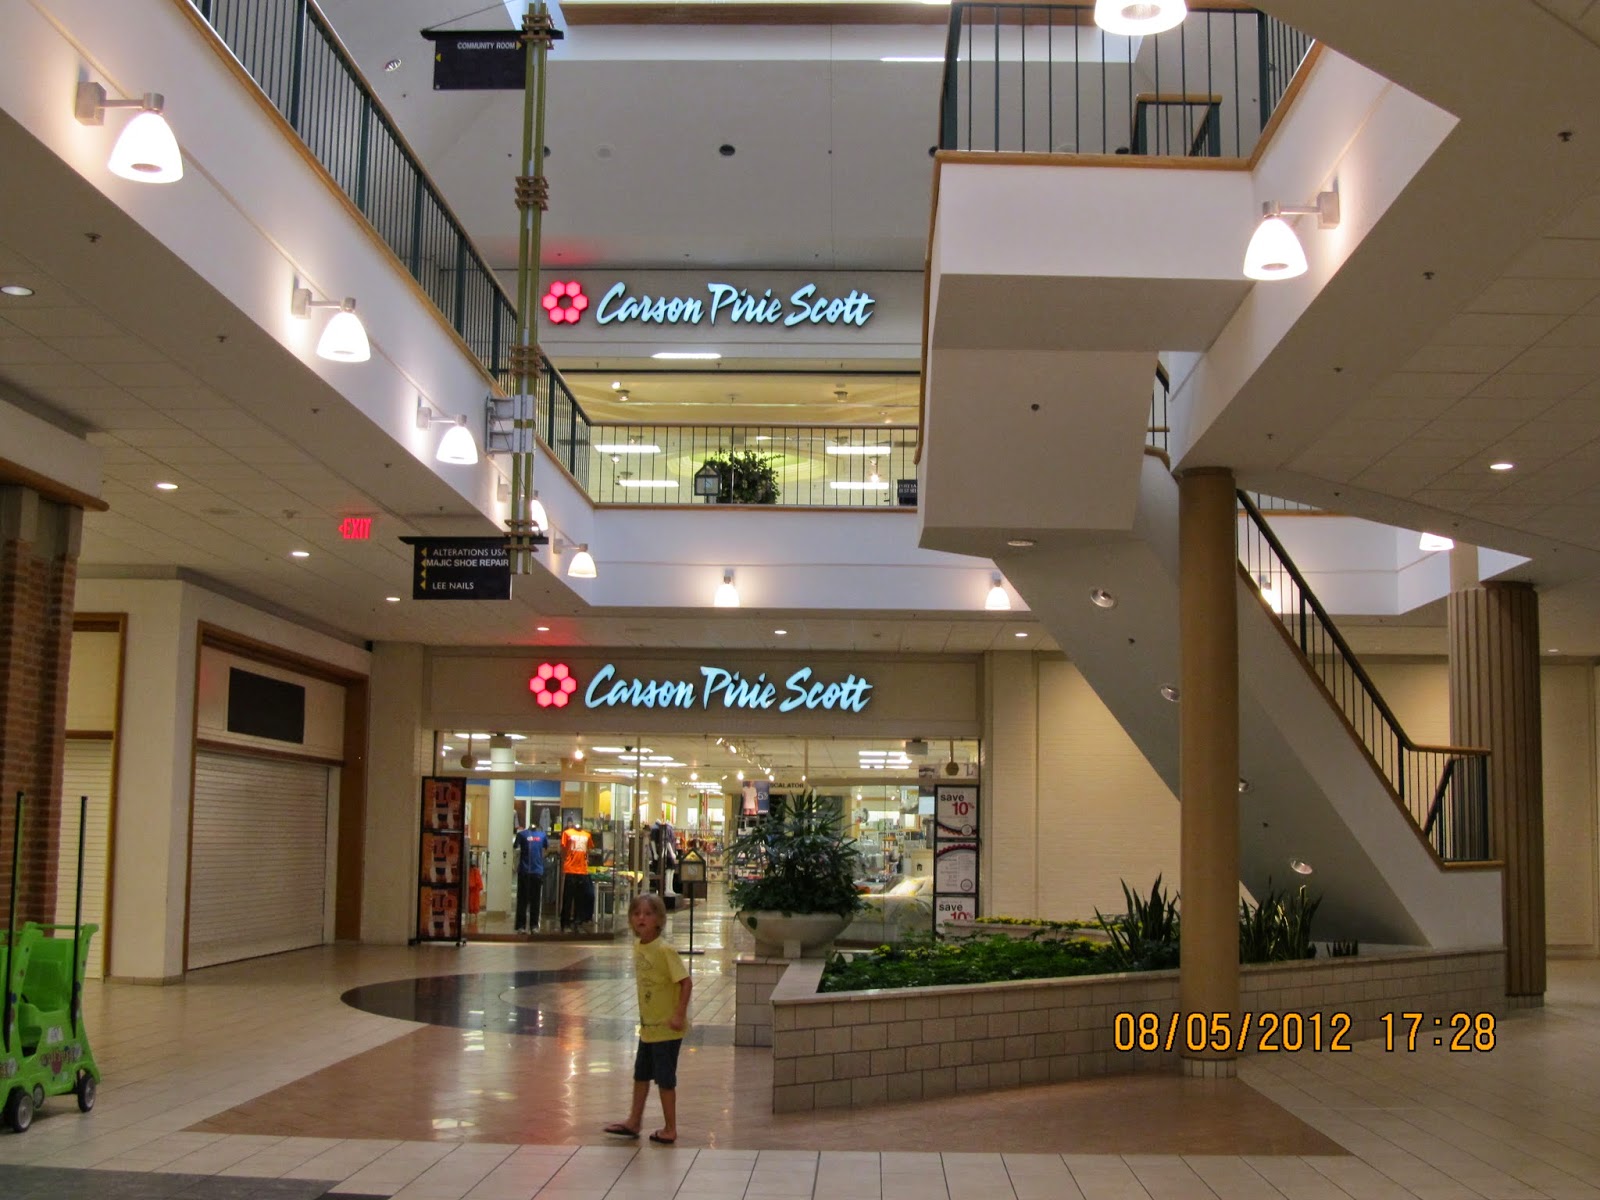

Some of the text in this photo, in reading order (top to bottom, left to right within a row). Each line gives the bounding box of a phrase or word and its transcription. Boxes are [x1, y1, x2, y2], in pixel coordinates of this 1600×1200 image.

[595, 281, 876, 327] Carson Pirie Scott
[343, 518, 372, 540] EXIT
[433, 548, 508, 556] ALTERATIONS USA
[426, 559, 509, 567] MAJIC SHOE REPAIR
[584, 663, 873, 712] Carson Pirie Scott
[940, 794, 965, 802] save
